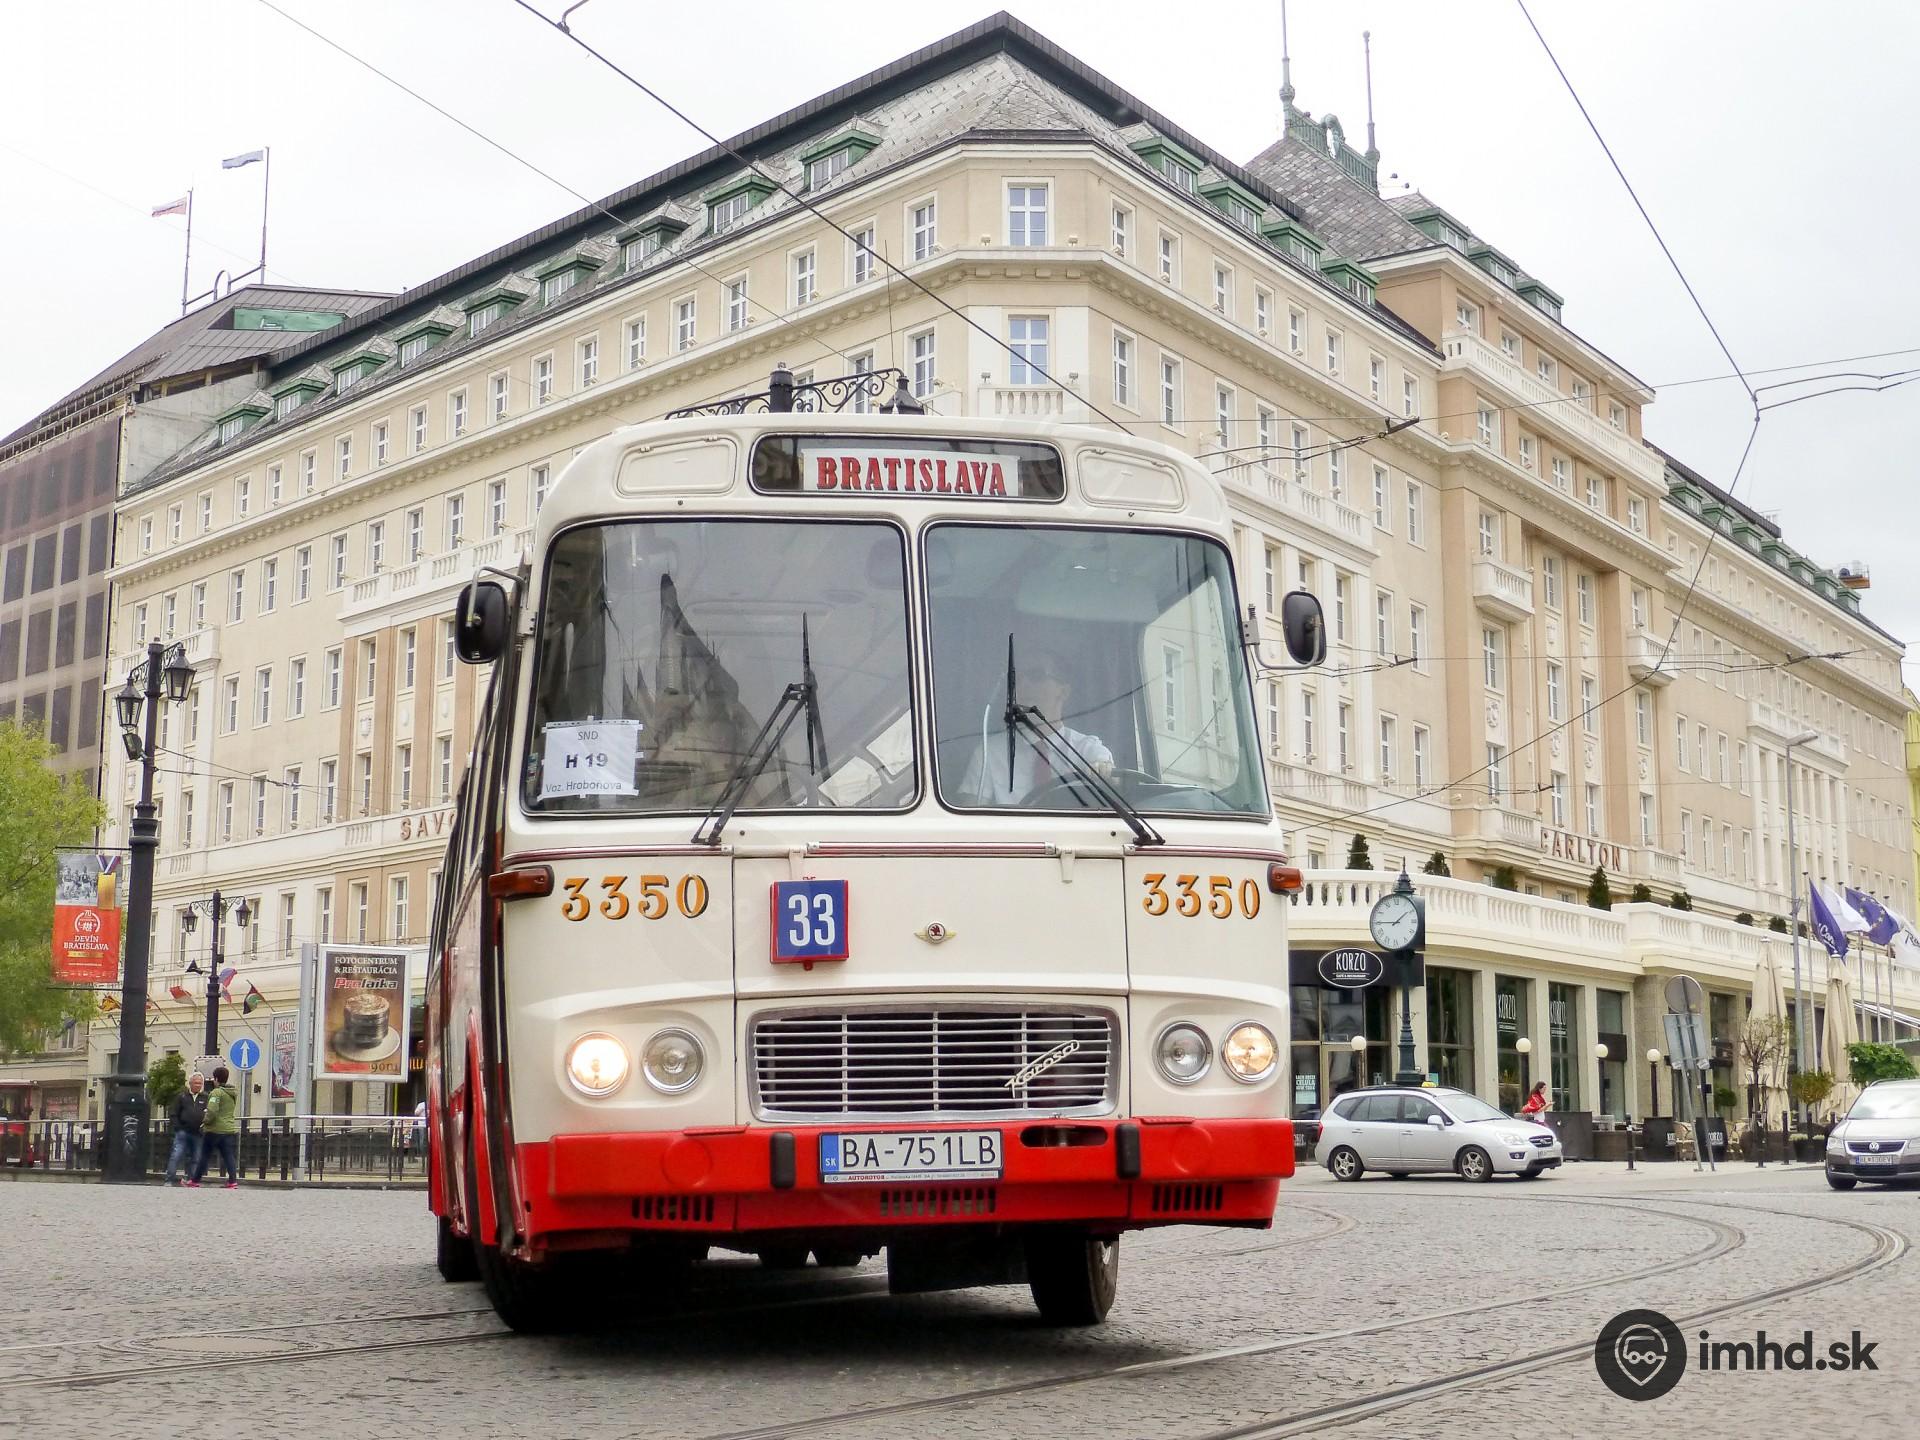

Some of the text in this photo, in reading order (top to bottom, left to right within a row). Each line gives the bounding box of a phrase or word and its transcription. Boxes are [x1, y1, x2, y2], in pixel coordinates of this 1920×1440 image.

[816, 456, 1007, 496] BRATISLAVA
[577, 731, 599, 741] SND
[565, 752, 608, 769] H 19
[1541, 829, 1621, 872] CARLTON
[561, 874, 709, 922] 3350
[1142, 873, 1260, 920] 3350
[788, 893, 836, 947] 33
[63, 942, 109, 951] BRATISLAVA
[74, 934, 99, 943] DEVÍN
[335, 966, 341, 974] &
[336, 957, 399, 965] FOTOCENTRUM
[1335, 952, 1367, 972] KORZO
[1498, 994, 1516, 1020] KORZO
[1550, 1000, 1566, 1025] KORZO
[825, 1158, 836, 1166] SK
[842, 1135, 996, 1168] BA-751LB
